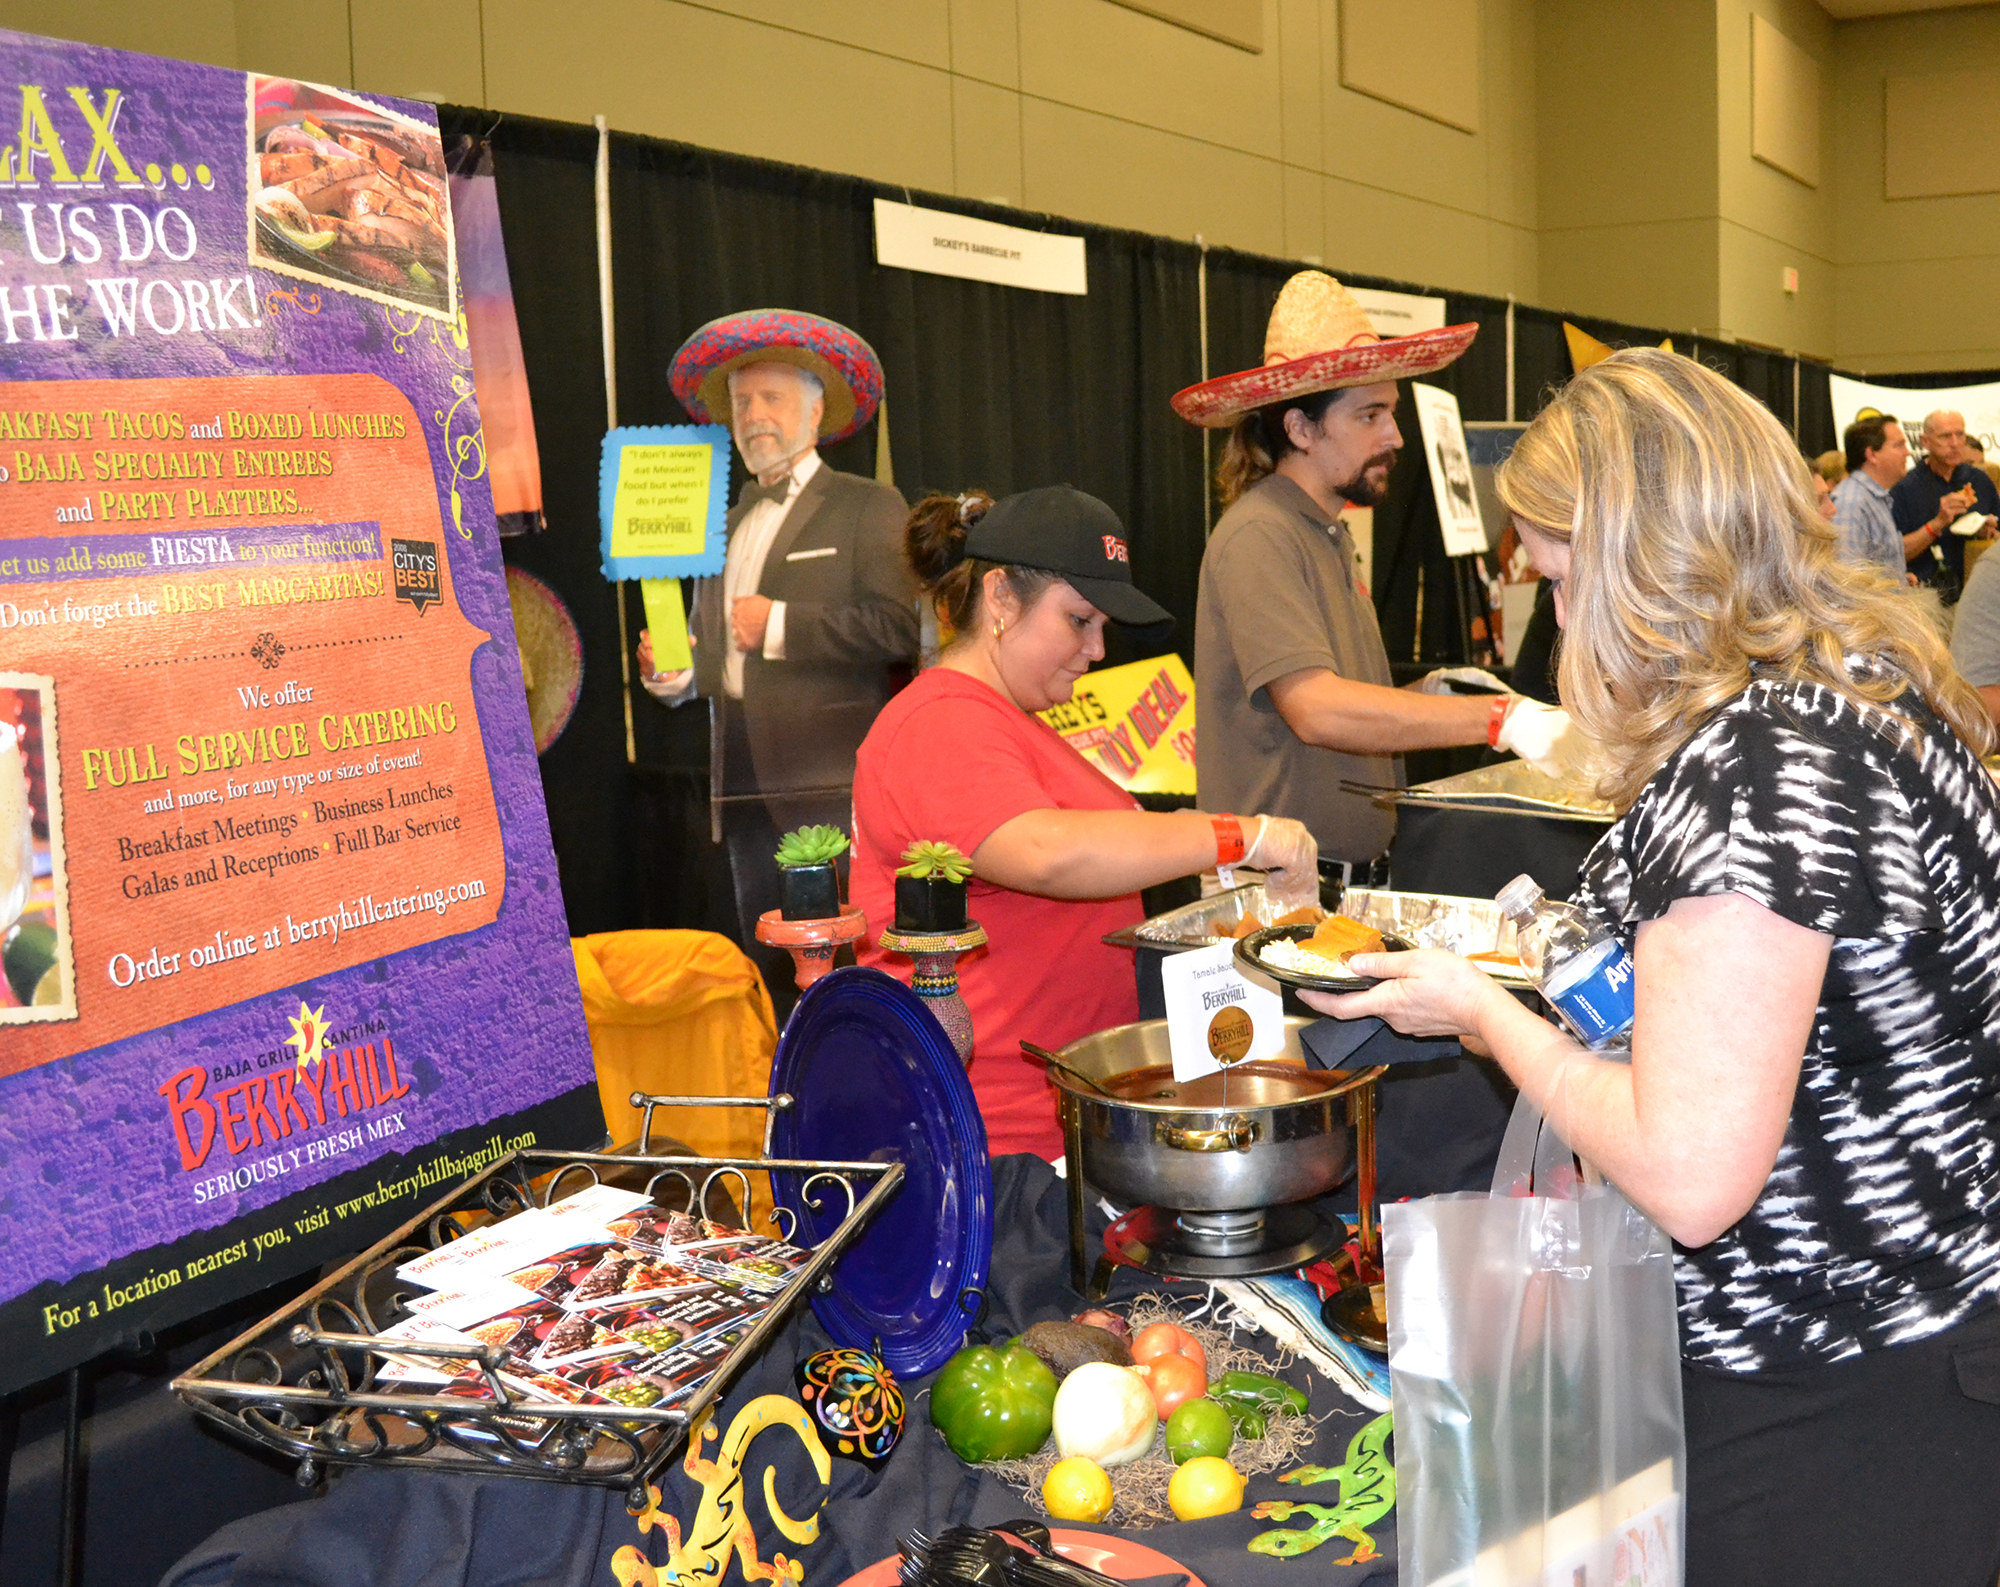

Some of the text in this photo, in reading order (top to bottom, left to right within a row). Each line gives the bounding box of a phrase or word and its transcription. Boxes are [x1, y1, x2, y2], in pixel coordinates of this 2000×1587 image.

[17, 203, 197, 264] US DO
[933, 237, 969, 253] DICKEY'S
[971, 243, 1008, 259] BARBECUE
[86, 274, 262, 338] WORK!
[102, 409, 185, 440] TACOS
[190, 416, 224, 439] and
[227, 410, 303, 439] BOXED
[309, 411, 406, 439] LUNCHES
[15, 451, 86, 482] BAJA
[93, 450, 224, 481] SPECIALTY
[233, 449, 334, 477] ENTREES
[634, 466, 695, 475] eat Mexican
[639, 450, 667, 458] don't
[668, 449, 703, 459] always
[623, 480, 647, 490] food
[650, 480, 667, 489] but
[669, 480, 698, 489] when
[635, 497, 649, 506] do
[657, 496, 689, 506] prefer
[57, 488, 314, 523] and PARTY PLATTERS...
[627, 517, 693, 536] BERRYHILL
[27, 558, 50, 573] us
[55, 546, 92, 573] add
[97, 551, 148, 570] some
[150, 536, 235, 567] FIESTA
[239, 544, 256, 561] to
[262, 543, 300, 567] your
[303, 532, 376, 558] function!
[394, 552, 436, 571] CITY'S
[395, 568, 436, 589] BEST
[0, 570, 385, 629] Don't forget the BEST MARGARITAS!
[237, 681, 315, 711] We offer
[1127, 667, 1189, 751] DEAL
[81, 700, 459, 790] FULL SERVICE CATERING
[143, 749, 423, 815] and more, for any type or size of event!
[117, 780, 455, 863] Breakfast Meetings Business Lunches
[122, 814, 462, 901] Galas and Receptions Full Bar Service
[108, 879, 487, 990] Order online at berryhillcatering.com
[1192, 966, 1216, 980] Tamale
[1604, 951, 1634, 994] Ame
[1202, 987, 1247, 1010] BERRYHILL
[213, 1018, 387, 1084] BAJA GRILL CANTINA
[1211, 1024, 1250, 1046] BERRYHILL
[157, 1037, 411, 1172] BERRYHILL
[193, 1112, 407, 1205] SERIOUSLY FRESH MEX
[43, 1130, 537, 1336] For a location nearest you, visit www.berryhillbajagrill.com
